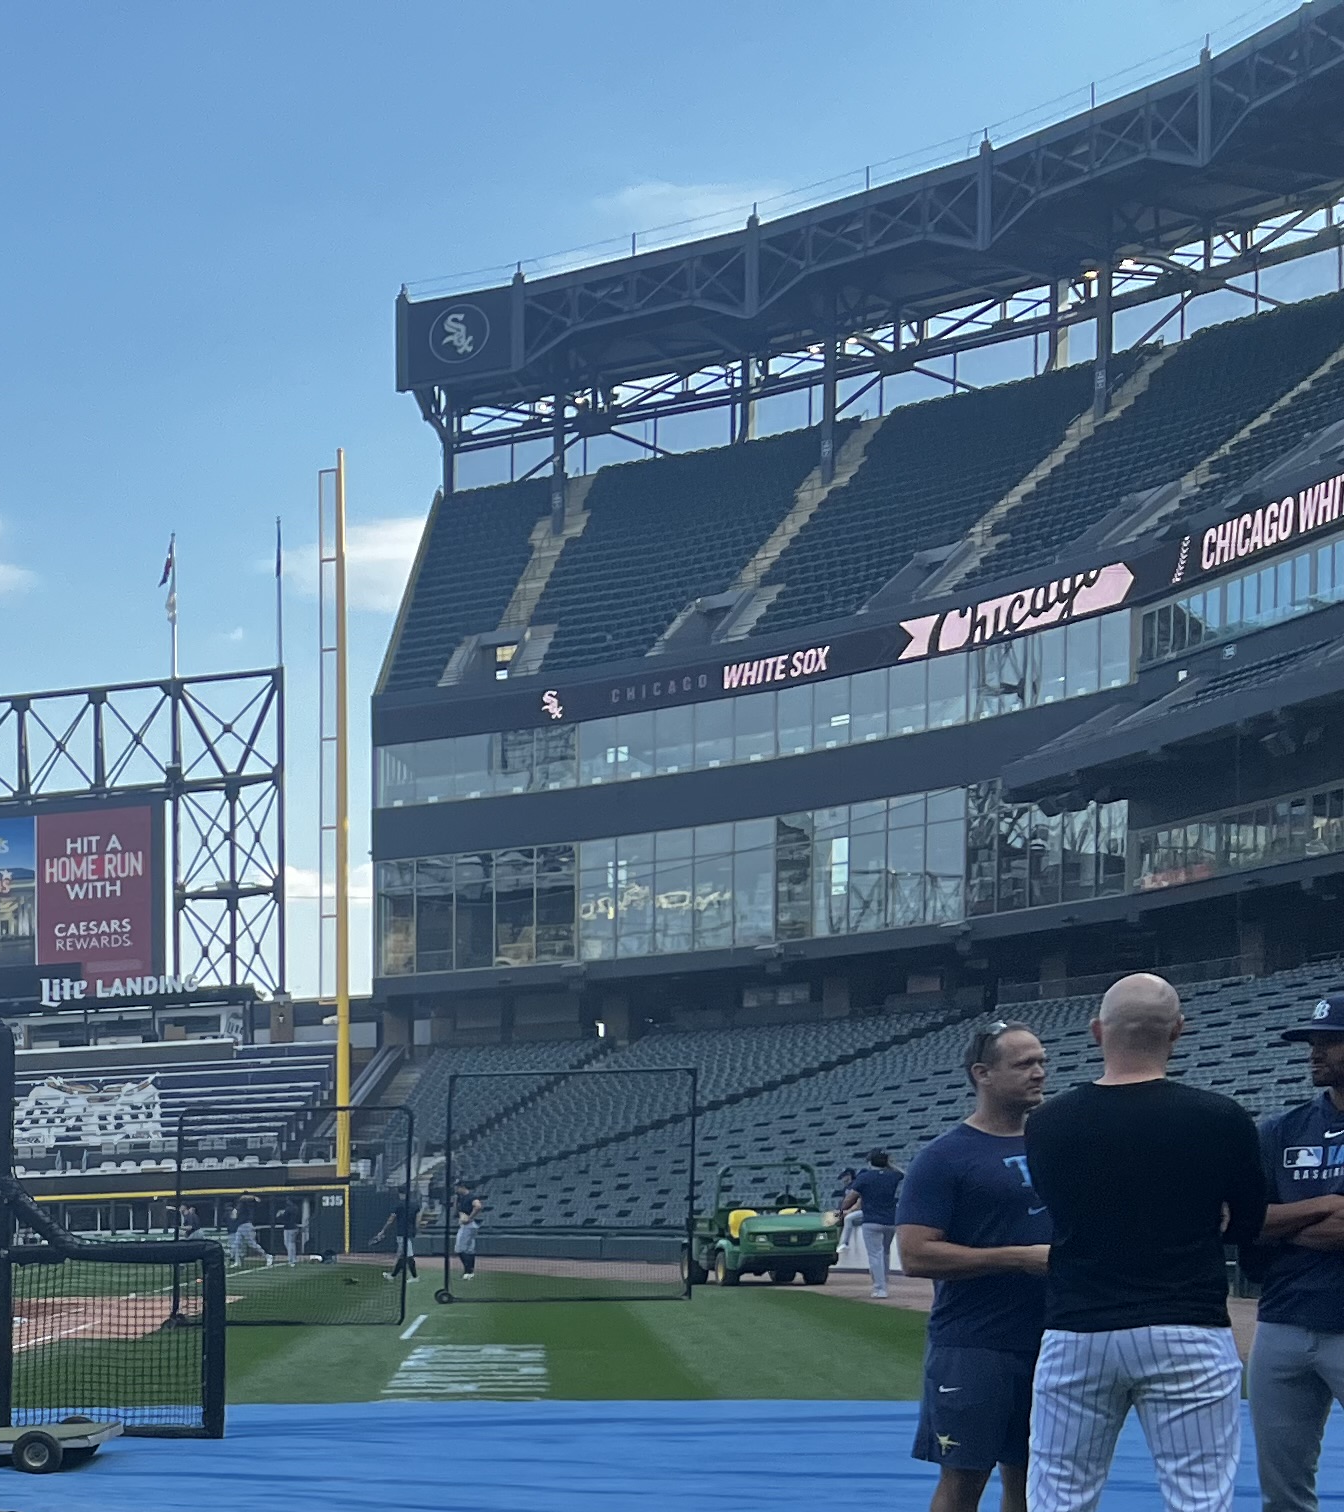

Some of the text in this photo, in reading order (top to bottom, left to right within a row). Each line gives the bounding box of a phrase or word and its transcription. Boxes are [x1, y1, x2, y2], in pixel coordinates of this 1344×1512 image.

[1201, 497, 1295, 570] CHICAGO
[611, 645, 830, 703] CHICAGO WHITE SOX
[66, 834, 122, 855] HIT A
[45, 851, 143, 884] HOME RUN
[66, 881, 121, 900] WITH
[54, 918, 131, 937] CAESARS
[40, 973, 199, 1007] Lite LANDING
[322, 1195, 343, 1207] 315
